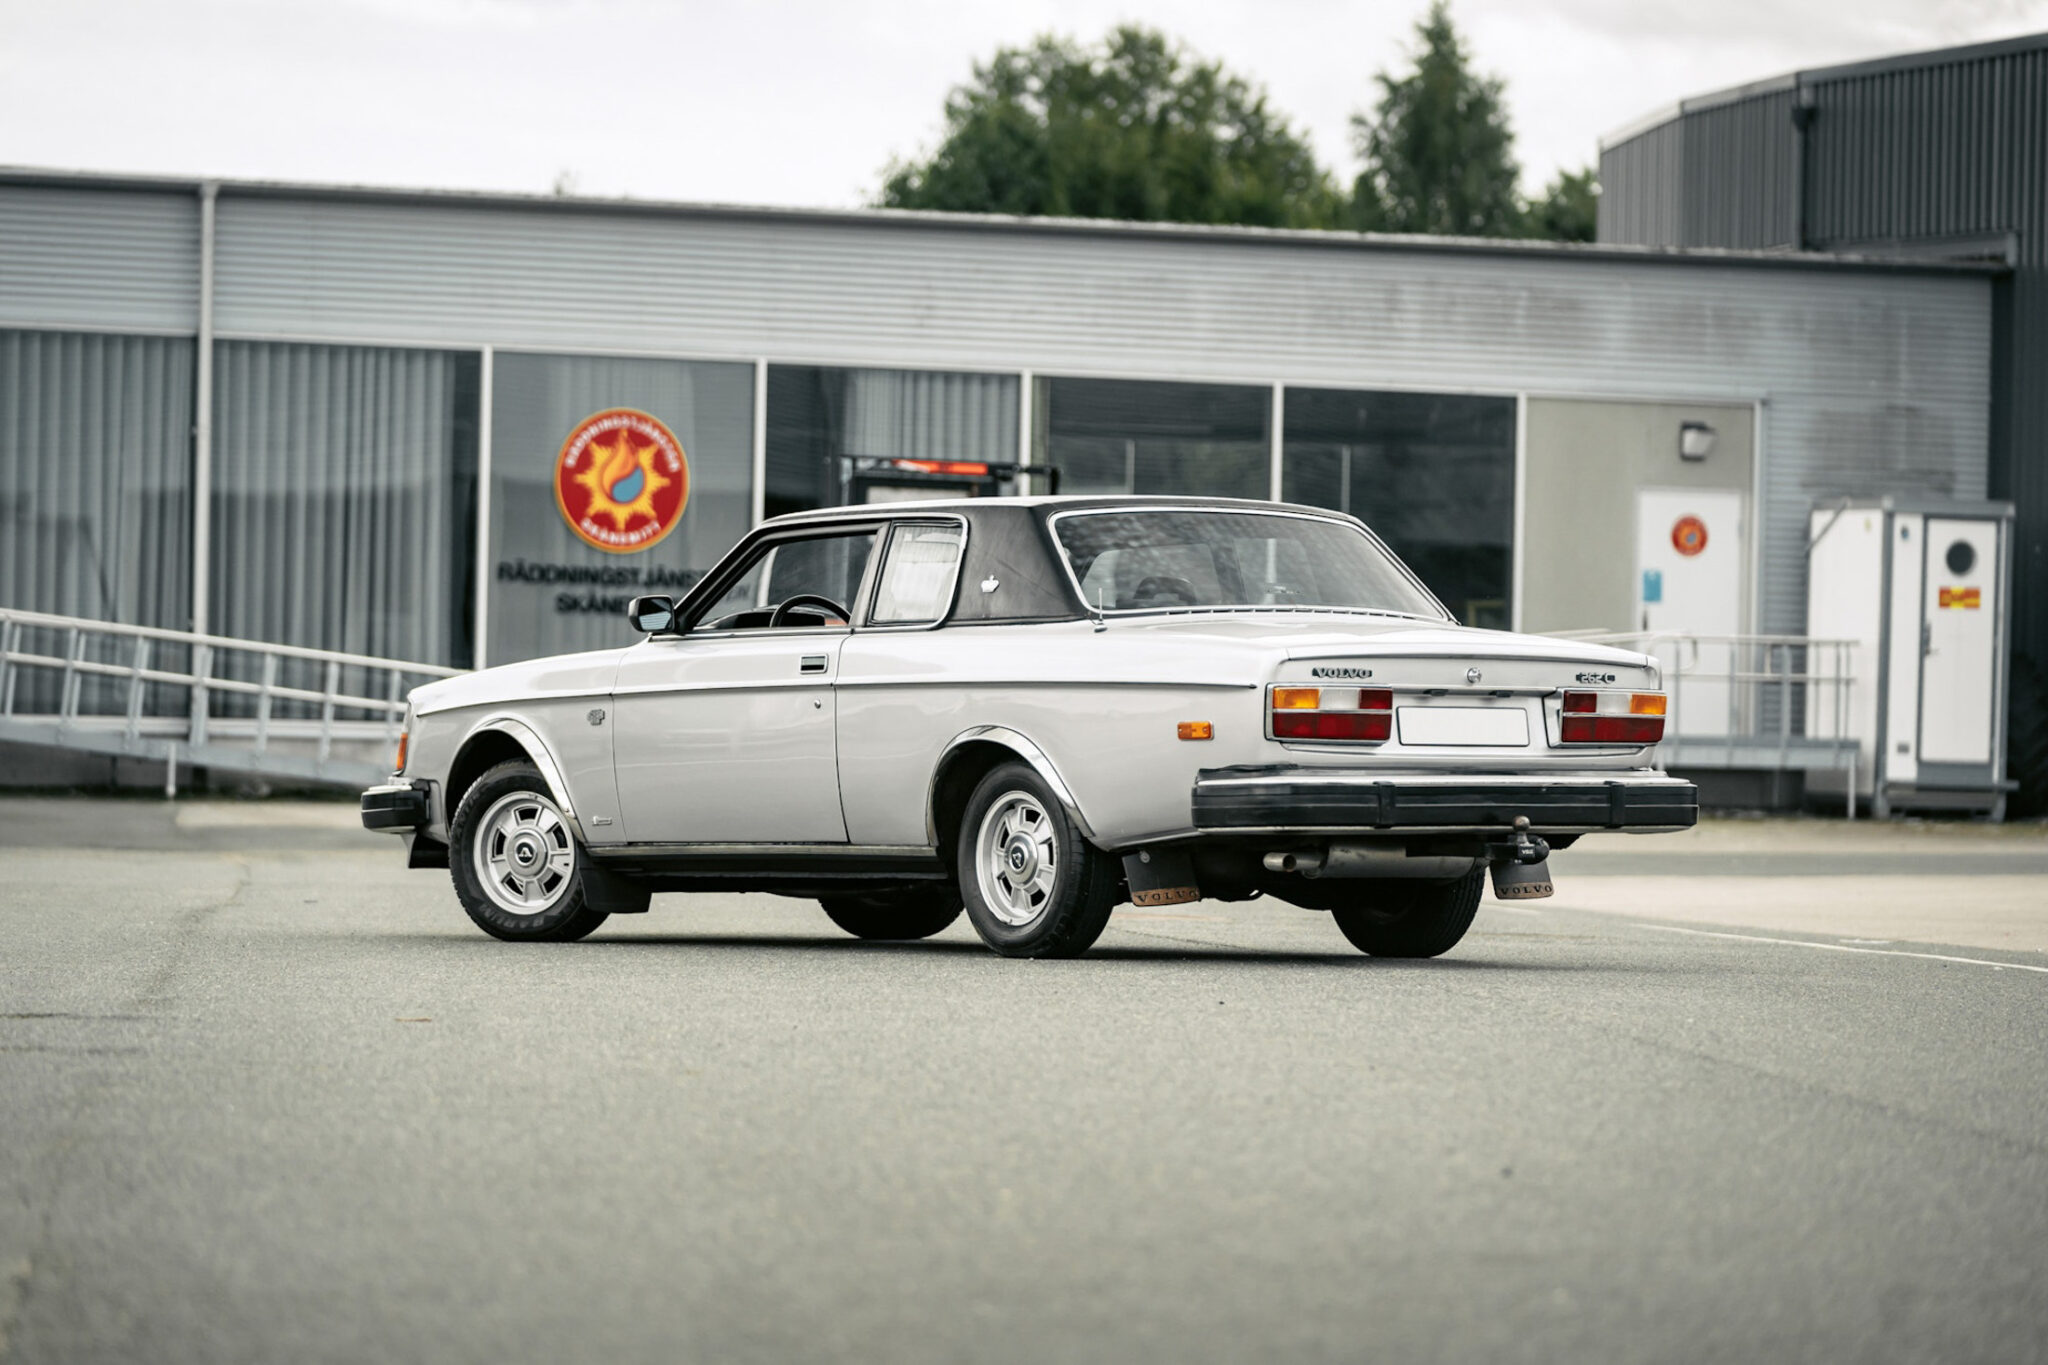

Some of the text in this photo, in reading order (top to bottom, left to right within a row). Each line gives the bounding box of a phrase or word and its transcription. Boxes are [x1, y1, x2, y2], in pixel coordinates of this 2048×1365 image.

[1314, 667, 1372, 679] VOLVO
[1135, 890, 1198, 902] VOLVO
[1500, 885, 1553, 895] VOLVO
